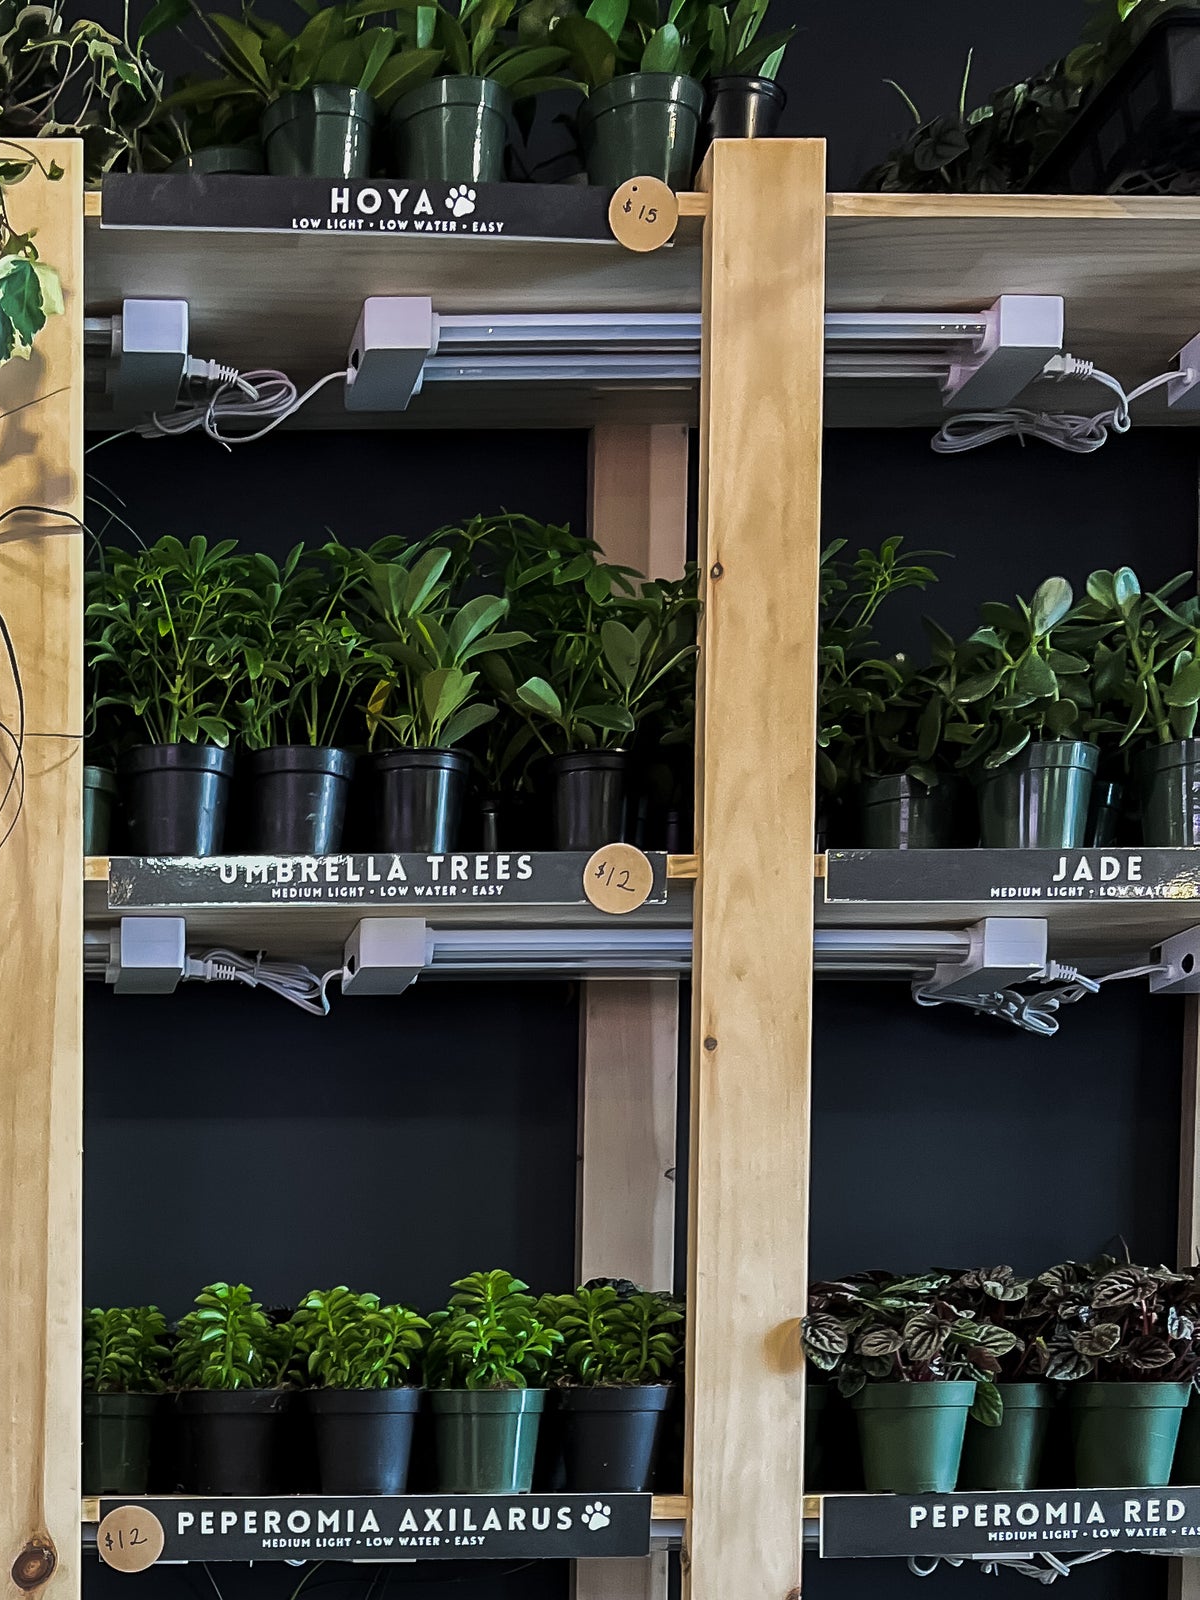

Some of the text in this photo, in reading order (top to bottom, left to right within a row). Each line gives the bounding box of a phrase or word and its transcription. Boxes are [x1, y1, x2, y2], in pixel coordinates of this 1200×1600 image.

[332, 188, 433, 214] HOYA
[292, 217, 504, 233] LOW LIGHT LOW WATER EASY
[220, 855, 532, 884] UMBRELLA TREES
[1053, 856, 1141, 881] JADE
[271, 885, 504, 899] MEDIUM LIGHT LOW WATER EASY
[990, 887, 1042, 898] MEDIUM
[1046, 886, 1085, 897] LIGHT
[1099, 885, 1129, 897] LOW
[179, 1507, 571, 1534] PEPEROMIA AXILARUS
[911, 1500, 1185, 1528] PEPEROMIA RED
[262, 1536, 486, 1548] MEDIUM LIGHT LOW WATER EASY
[988, 1531, 1037, 1541] MEDIUM
[1042, 1529, 1079, 1540] LIGHT
[1092, 1528, 1121, 1539] LOW
[1125, 1527, 1167, 1537] WATER
